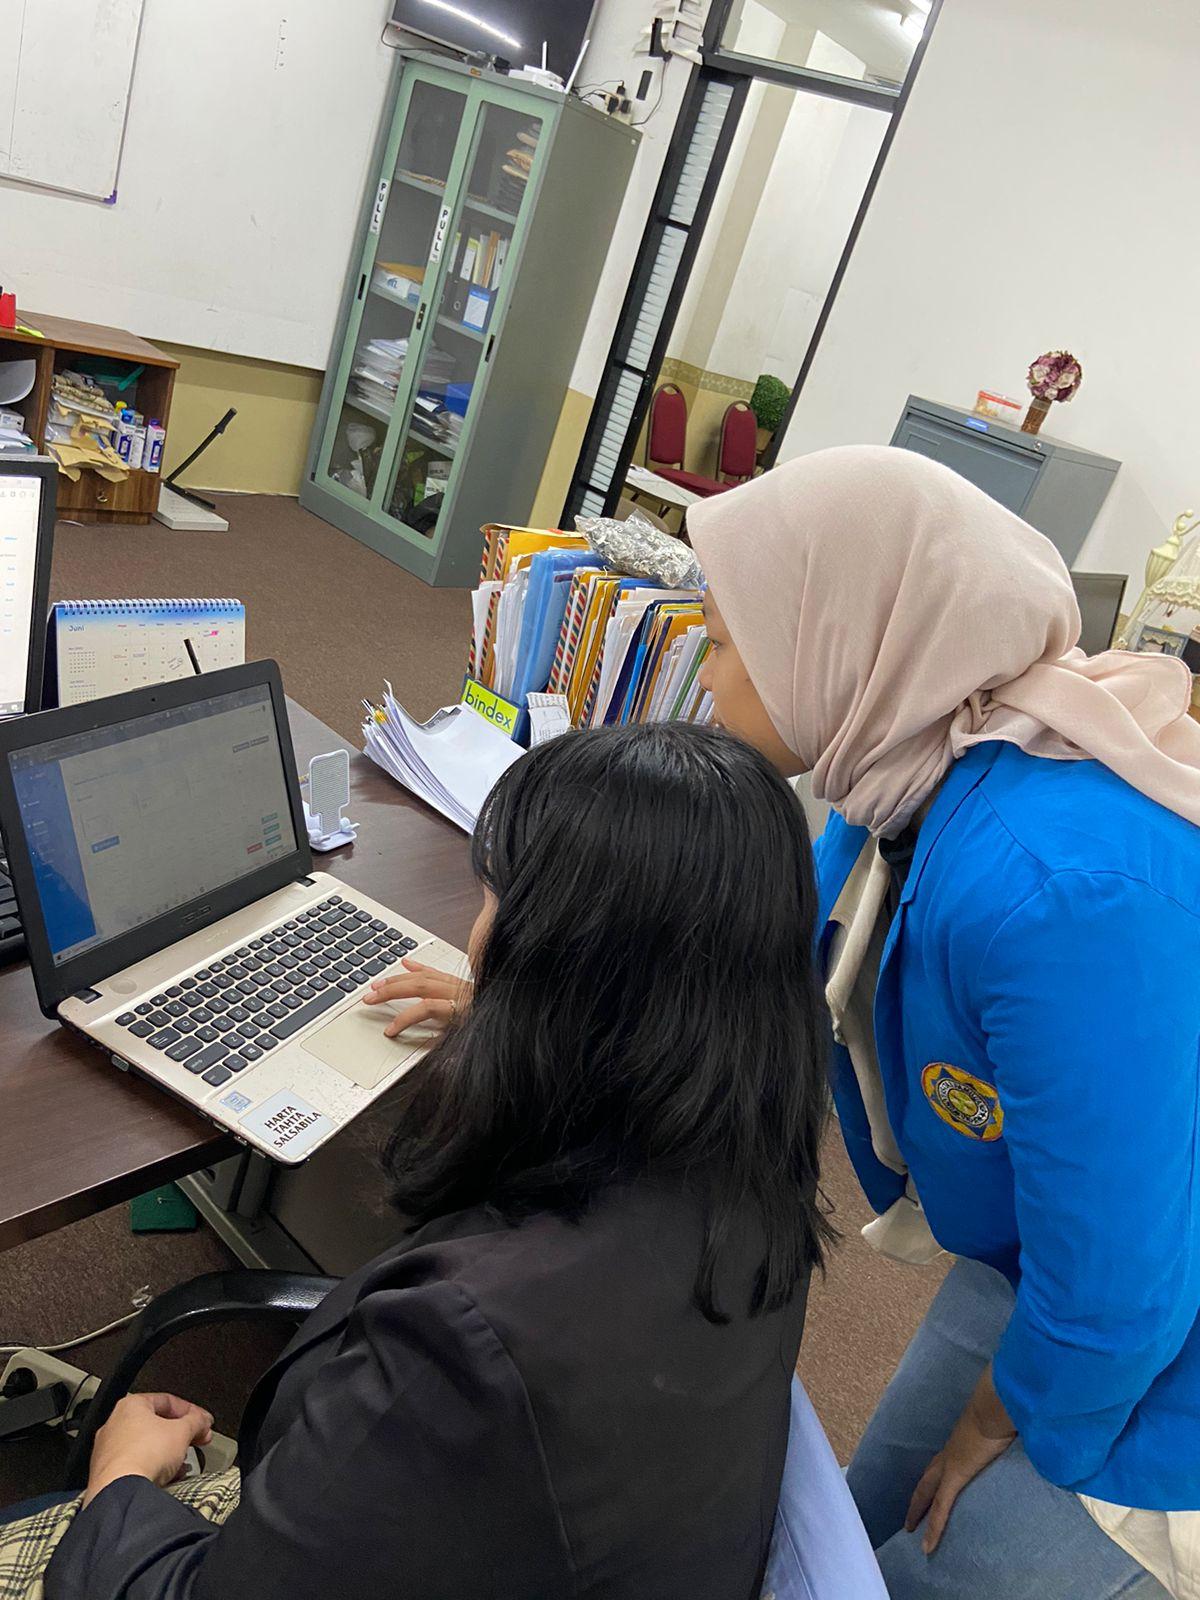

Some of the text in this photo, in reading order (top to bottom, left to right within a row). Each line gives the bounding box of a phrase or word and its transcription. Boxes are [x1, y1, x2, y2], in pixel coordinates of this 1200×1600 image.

[374, 182, 387, 224] PULL
[434, 209, 448, 252] PULL
[68, 624, 85, 632] Juni
[464, 684, 512, 730] bindex
[264, 1105, 297, 1129] HARTA
[273, 1112, 305, 1135] TAHTA
[273, 1112, 322, 1148] SALSABILA
